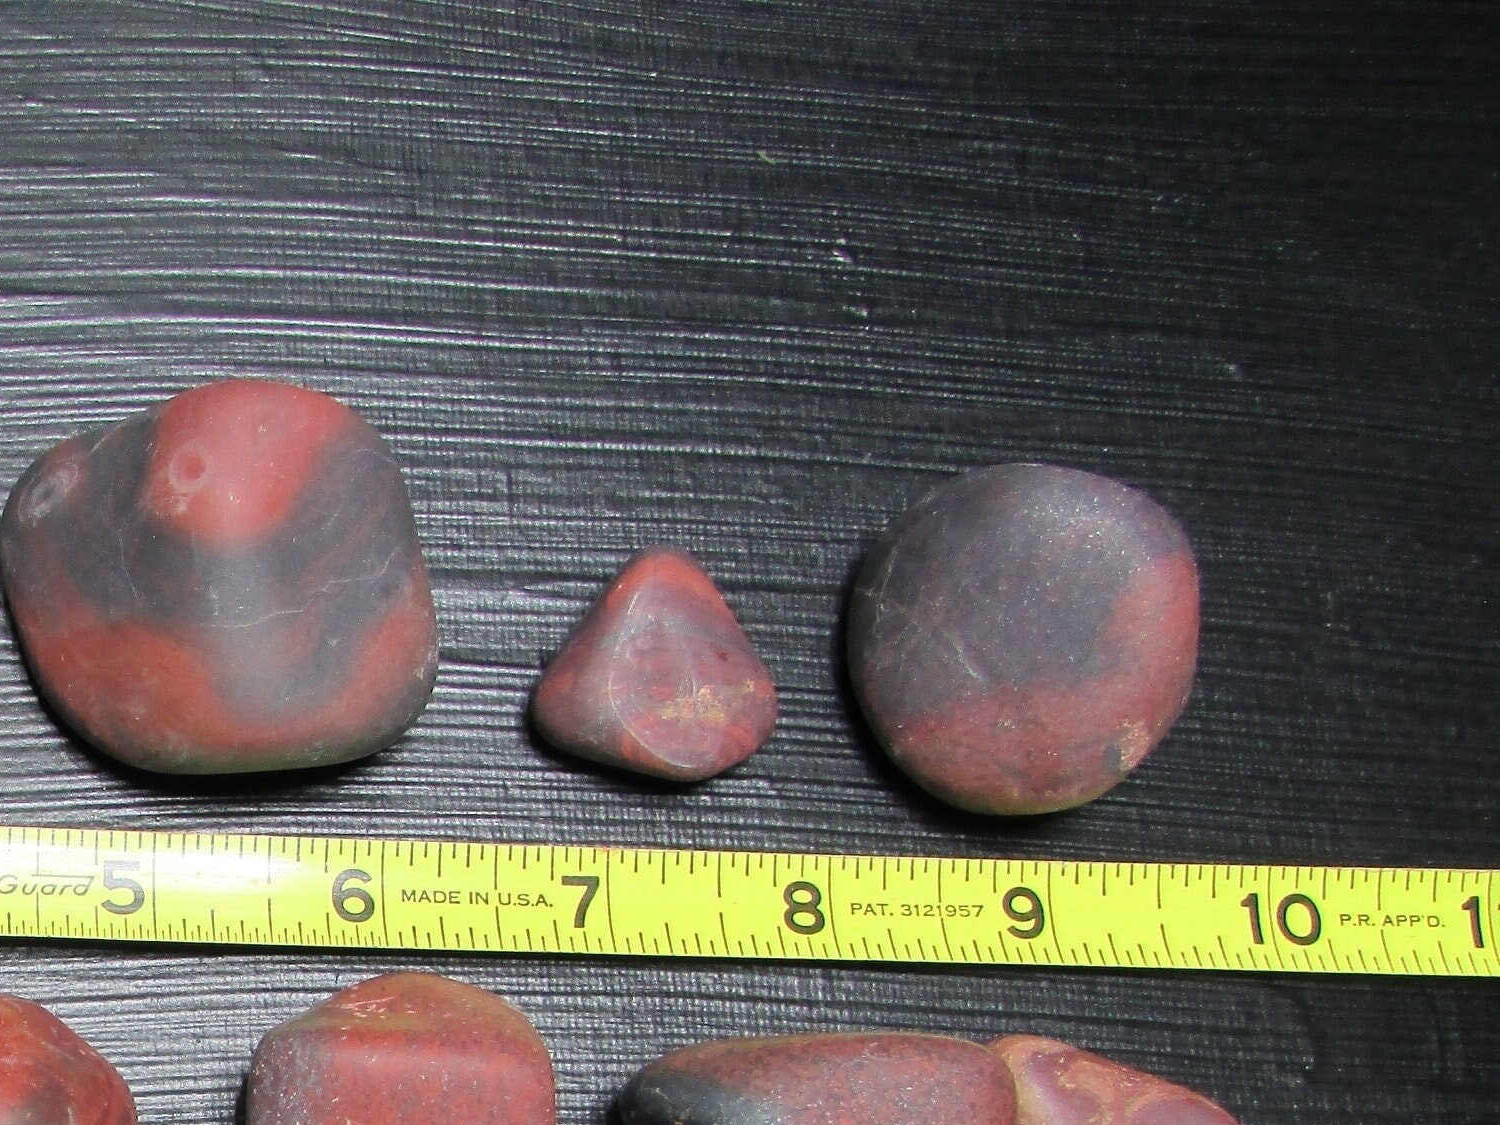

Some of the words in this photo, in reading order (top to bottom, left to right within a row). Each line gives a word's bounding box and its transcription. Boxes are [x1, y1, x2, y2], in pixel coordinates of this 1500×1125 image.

[100, 860, 145, 915] 5
[331, 868, 375, 922] 6
[401, 889, 461, 905] MADE
[469, 891, 489, 905] IN
[498, 892, 554, 908] U.S.A.
[561, 875, 600, 929] 7
[783, 881, 825, 935] 8
[850, 902, 894, 917] PAT.
[900, 903, 984, 918] 3121957
[1002, 886, 1045, 940] 9
[1240, 892, 1322, 946] 10
[1339, 913, 1375, 926] P.R.
[1382, 914, 1446, 928] APP'D.
